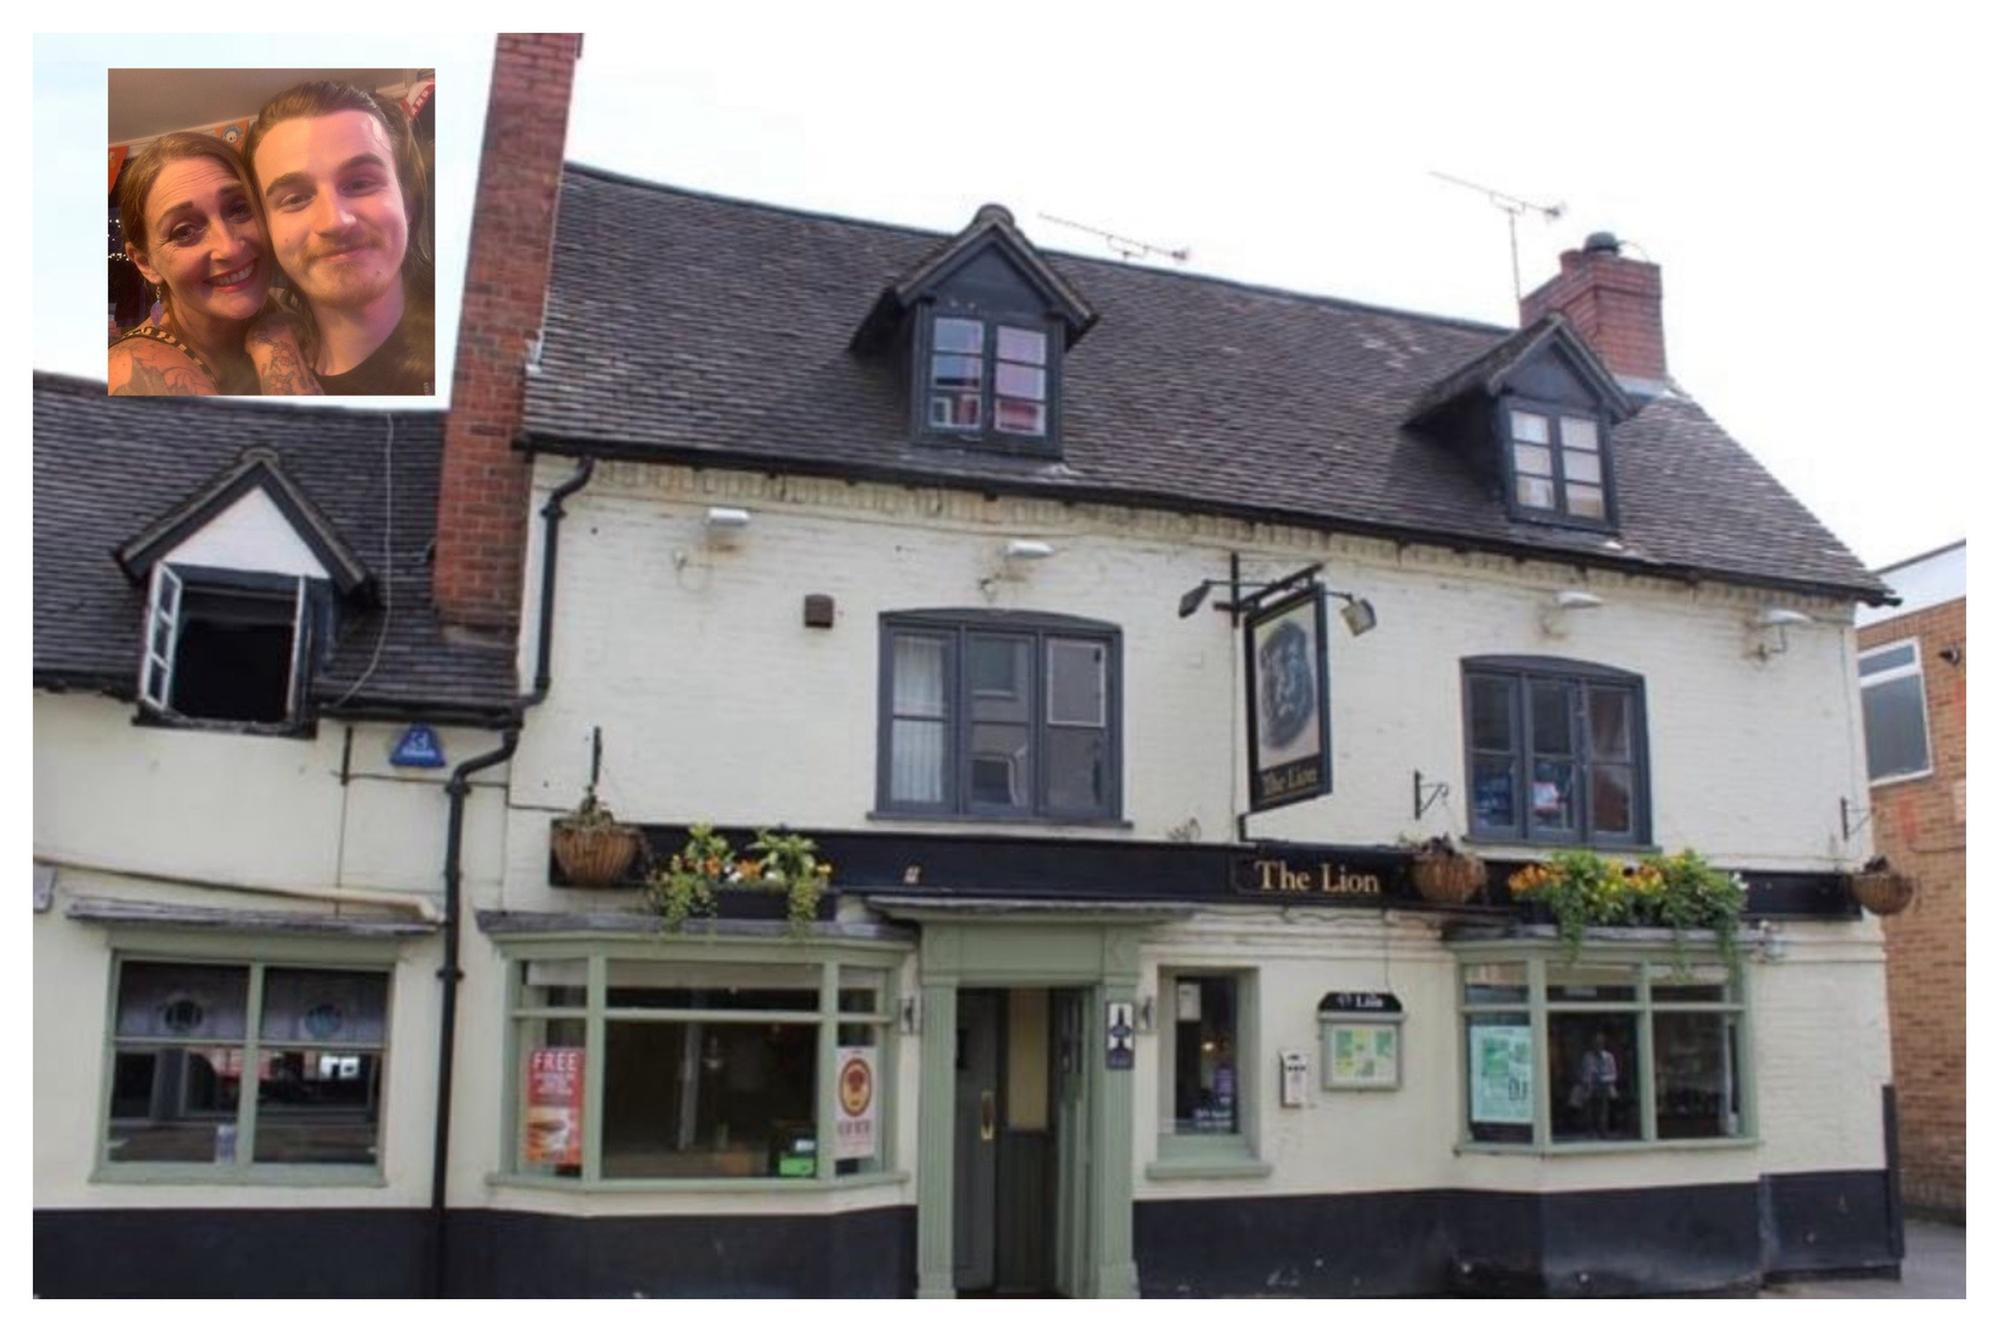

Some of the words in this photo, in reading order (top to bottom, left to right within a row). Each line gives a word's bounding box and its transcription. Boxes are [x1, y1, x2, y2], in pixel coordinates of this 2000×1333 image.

[1254, 860, 1310, 891] The
[1320, 863, 1381, 893] Lion
[533, 1052, 578, 1072] FREE
